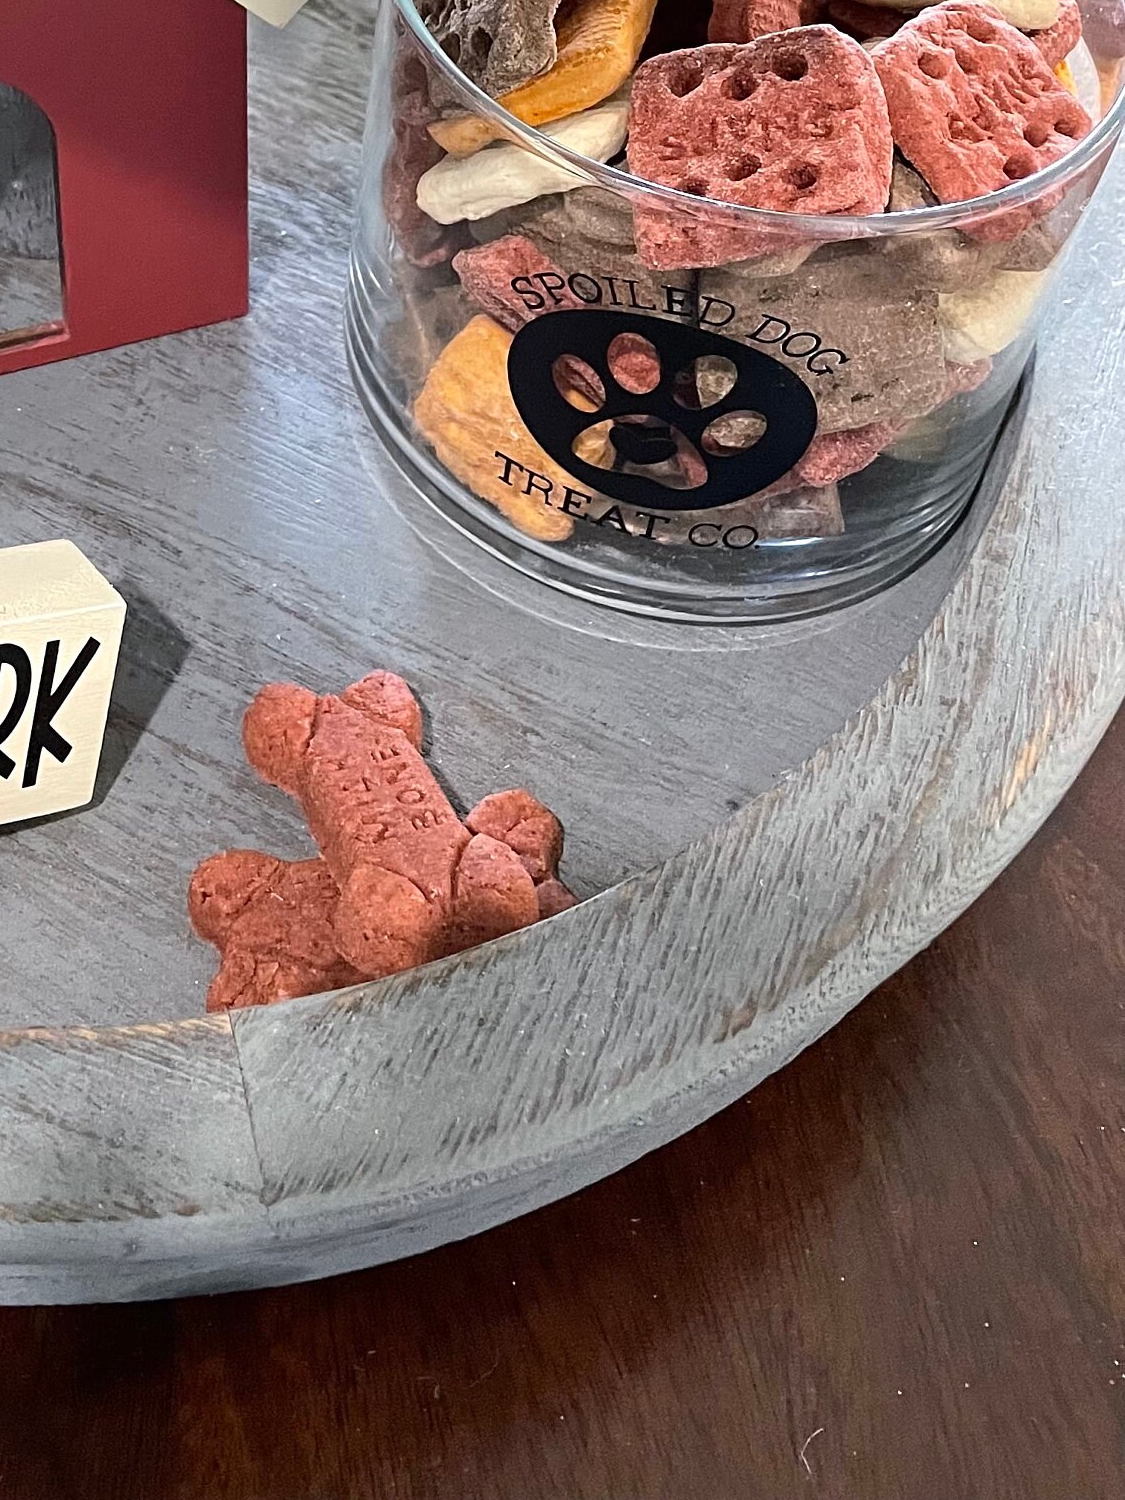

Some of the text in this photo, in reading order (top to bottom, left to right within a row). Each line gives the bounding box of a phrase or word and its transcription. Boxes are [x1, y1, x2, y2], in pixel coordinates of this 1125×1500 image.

[510, 271, 851, 378] SPOILED DOG
[493, 451, 761, 550] TREAT CO.
